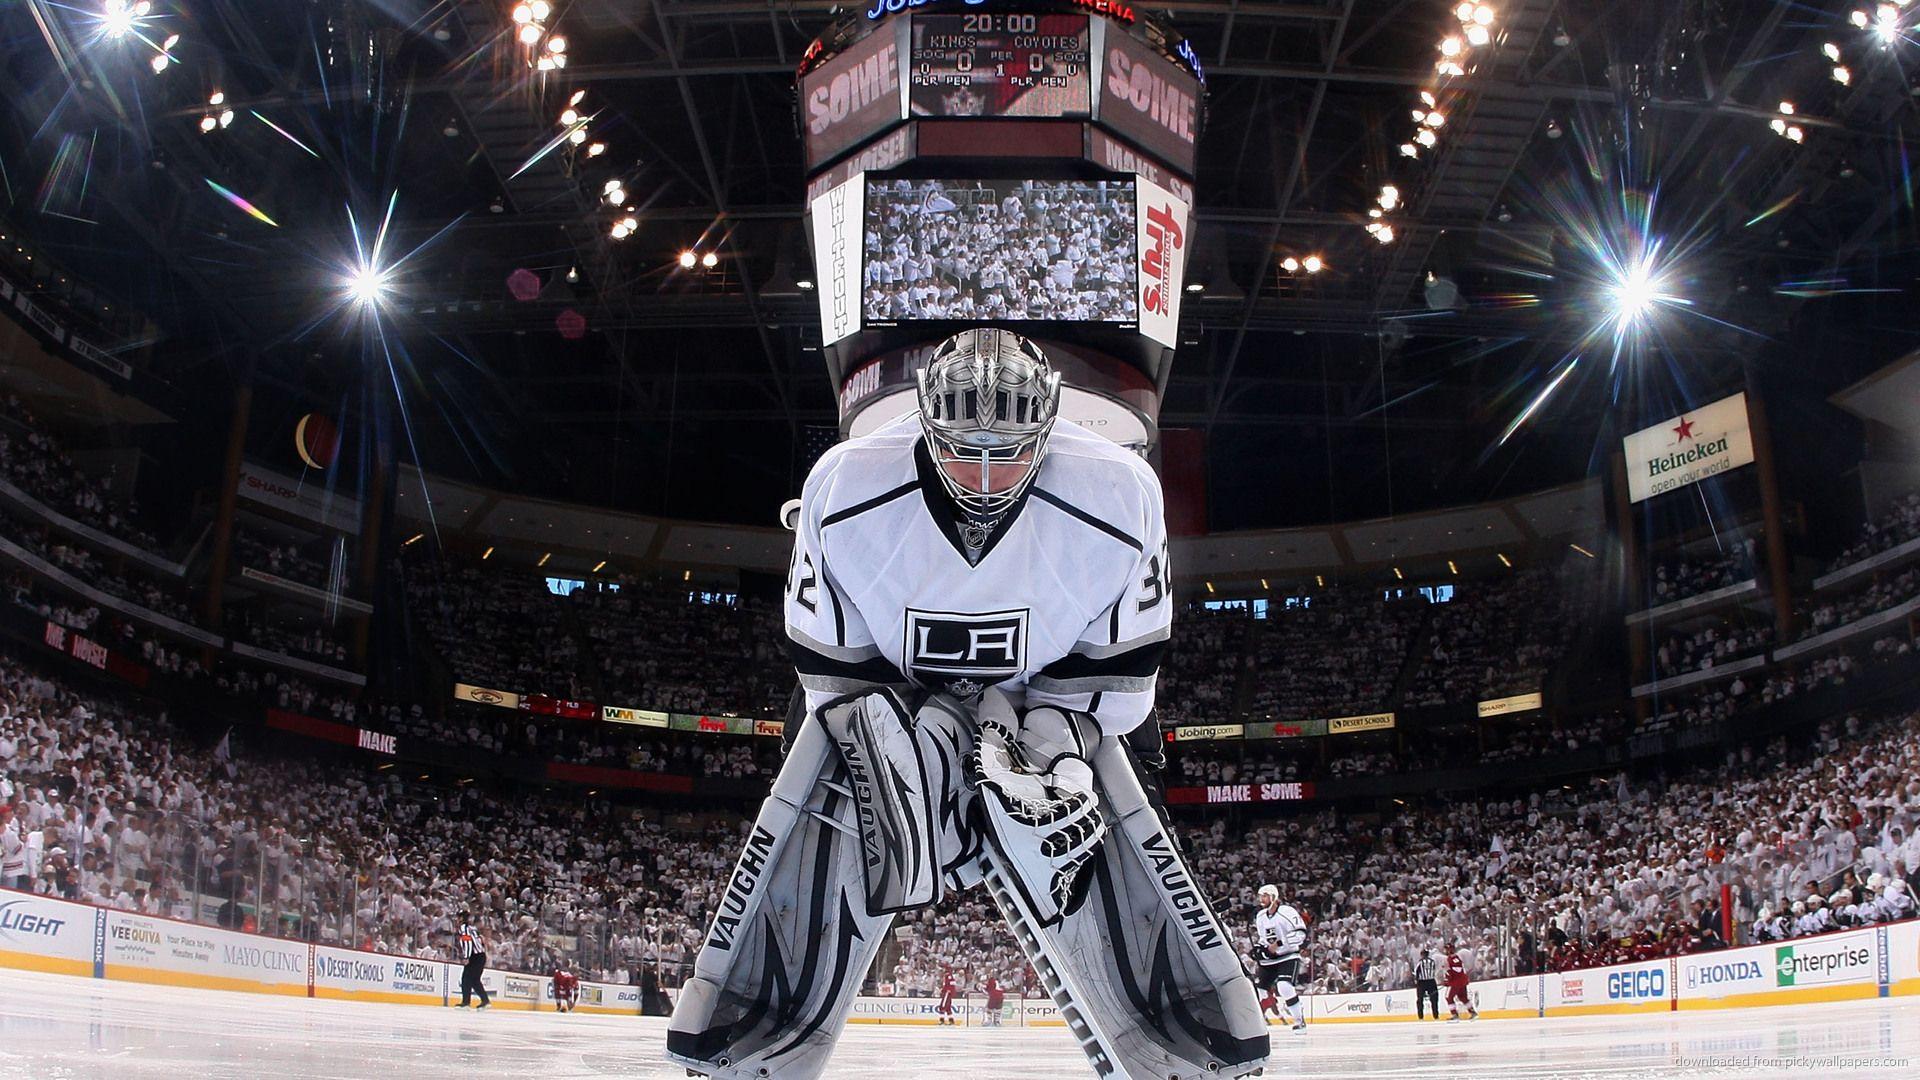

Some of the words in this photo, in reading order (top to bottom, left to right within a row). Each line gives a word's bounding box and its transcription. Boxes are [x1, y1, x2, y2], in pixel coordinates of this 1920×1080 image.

[964, 14, 1036, 33] 20:00
[930, 35, 976, 48] KINGS
[1015, 36, 1078, 48] COYOTES
[1055, 52, 1086, 62] SOG
[995, 64, 1005, 77] 1
[810, 44, 898, 134] SOME
[1108, 48, 1196, 144] SOME
[829, 184, 848, 338] WHITEOUT
[1647, 436, 1729, 478] Heineken
[247, 476, 297, 498] SHARP
[1650, 477, 1677, 495] open
[1679, 470, 1701, 487] your
[1703, 456, 1730, 476] world
[916, 625, 1018, 662] LA
[605, 707, 633, 721] WM
[358, 728, 397, 755] MAKE
[1180, 725, 1234, 739] Jobing.com
[838, 741, 882, 867] VAUGHN
[1207, 785, 1251, 803] MAKE
[1261, 782, 1303, 800] SOME
[707, 825, 777, 951] VAUGHN
[1141, 831, 1222, 950] VAUGHN
[1, 909, 66, 936] LIGHT
[95, 908, 106, 963] Reebok
[112, 925, 131, 940] VEE
[131, 929, 161, 944] QUIVA
[224, 944, 261, 968] MAYO
[262, 950, 302, 973] CLINIC
[328, 956, 353, 979] DESERT
[354, 961, 384, 982] SCHOOLS
[1778, 946, 1870, 976] enterprise
[404, 963, 434, 982] ARIZONA
[1608, 969, 1664, 999] GEICO
[1700, 961, 1762, 984] HONDA
[854, 1002, 901, 1014] CLINIC
[1348, 1001, 1372, 1013] verizon
